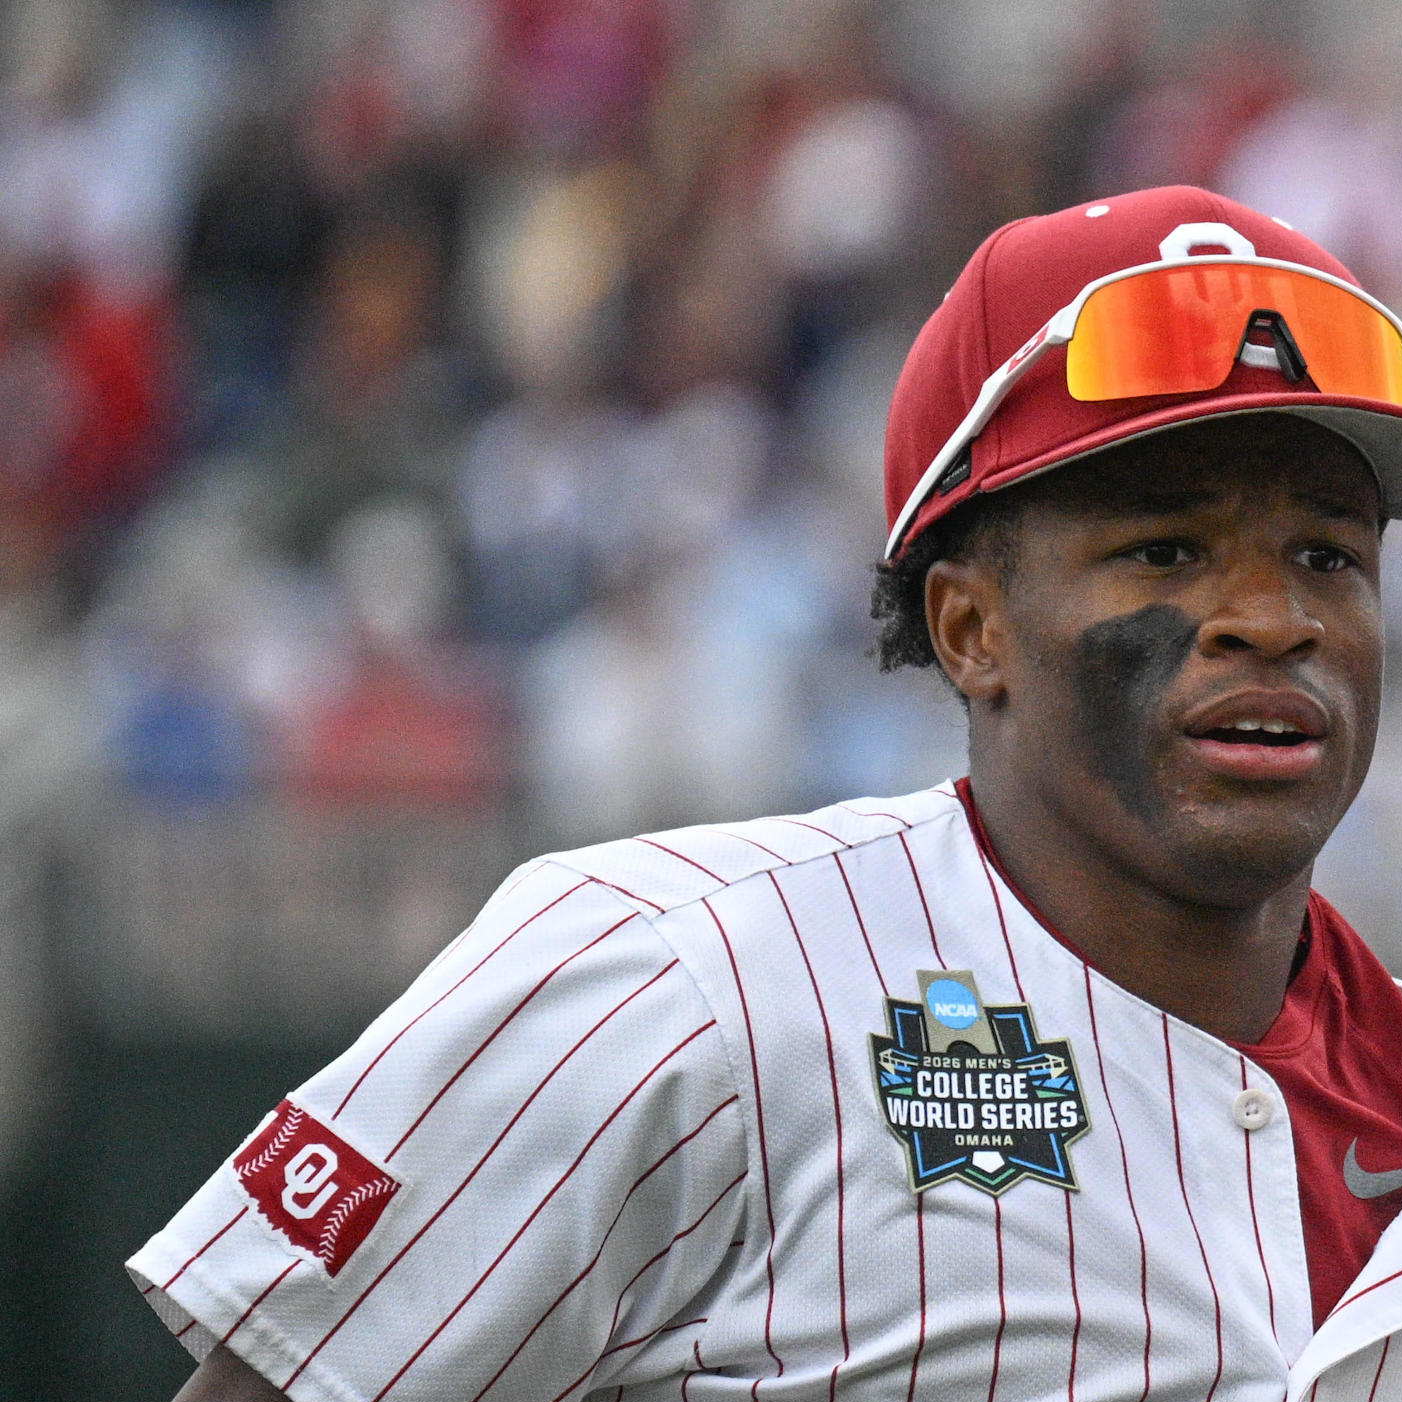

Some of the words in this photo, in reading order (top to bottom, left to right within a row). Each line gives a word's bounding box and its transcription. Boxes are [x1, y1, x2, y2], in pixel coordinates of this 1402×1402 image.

[935, 1002, 978, 1018] NCAA
[923, 1056, 960, 1069] 2026
[965, 1057, 1012, 1069] MEN'S
[916, 1070, 1028, 1100] COLLEGE
[887, 1097, 974, 1130] WORLD
[981, 1100, 1078, 1130] SERIES
[955, 1134, 1014, 1146] OMAHA
[281, 1143, 340, 1220] OU
